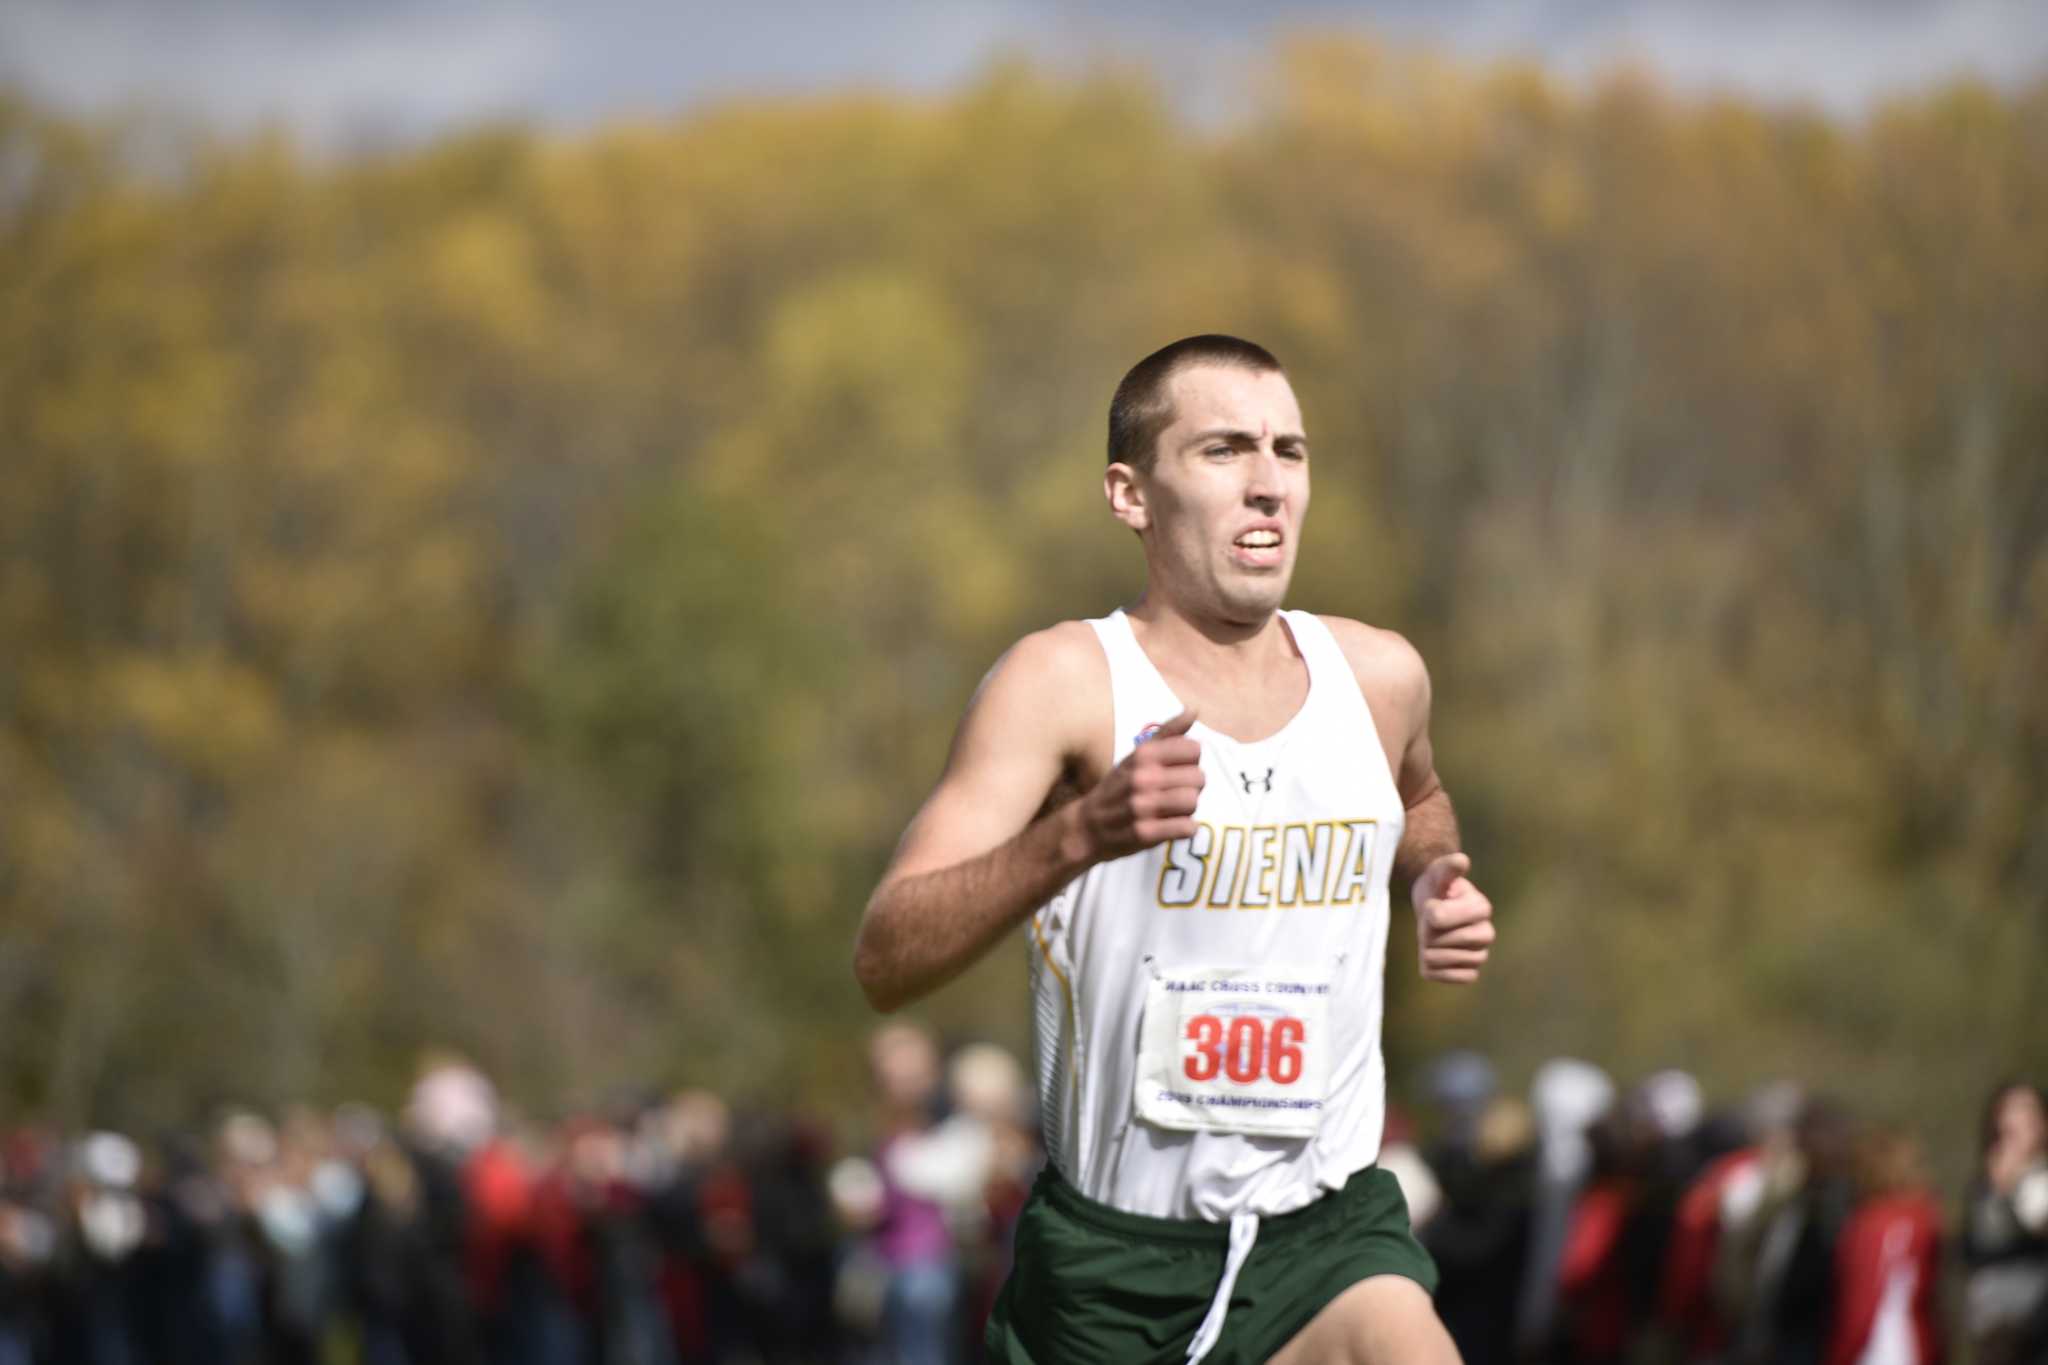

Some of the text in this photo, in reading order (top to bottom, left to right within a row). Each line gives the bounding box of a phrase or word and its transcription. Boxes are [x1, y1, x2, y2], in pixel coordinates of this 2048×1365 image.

[1157, 820, 1377, 908] SIENA
[1211, 979, 1260, 992] CROSS
[1184, 1014, 1306, 1084] 306
